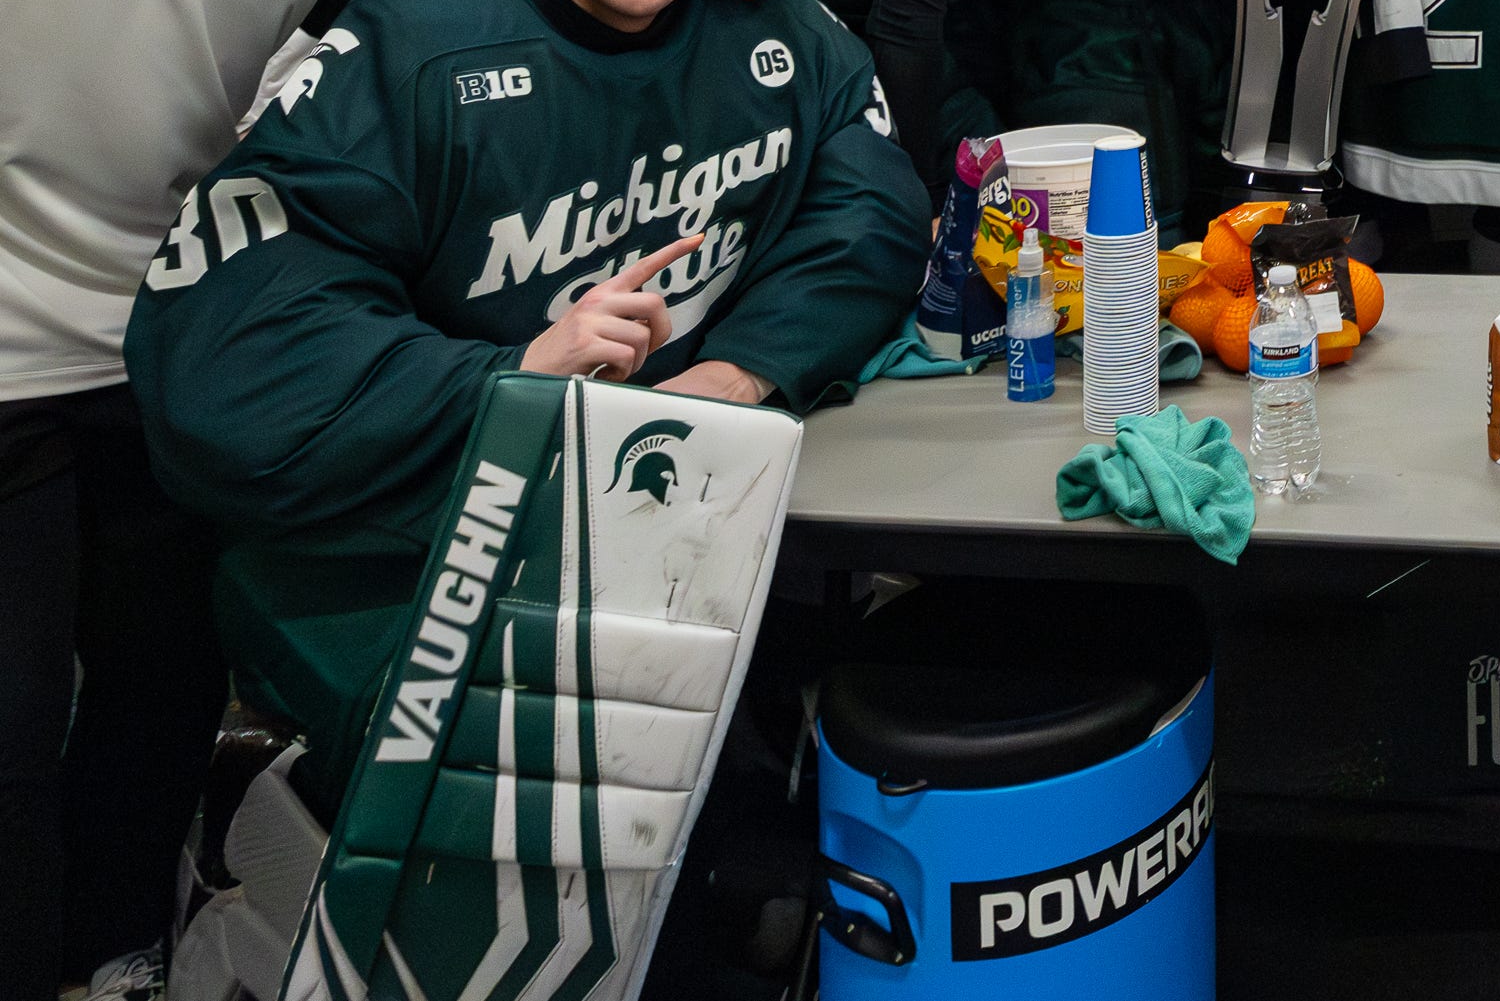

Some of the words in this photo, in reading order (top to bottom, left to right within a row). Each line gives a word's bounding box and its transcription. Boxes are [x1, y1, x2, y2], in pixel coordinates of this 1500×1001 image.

[755, 48, 789, 78] DS
[466, 127, 792, 300] Michigan
[1140, 151, 1154, 229] POWERADE
[145, 177, 289, 292] 30
[1010, 338, 1026, 393] LENS
[1263, 347, 1299, 357] KIRKLAND
[375, 460, 528, 762] VAUGHN
